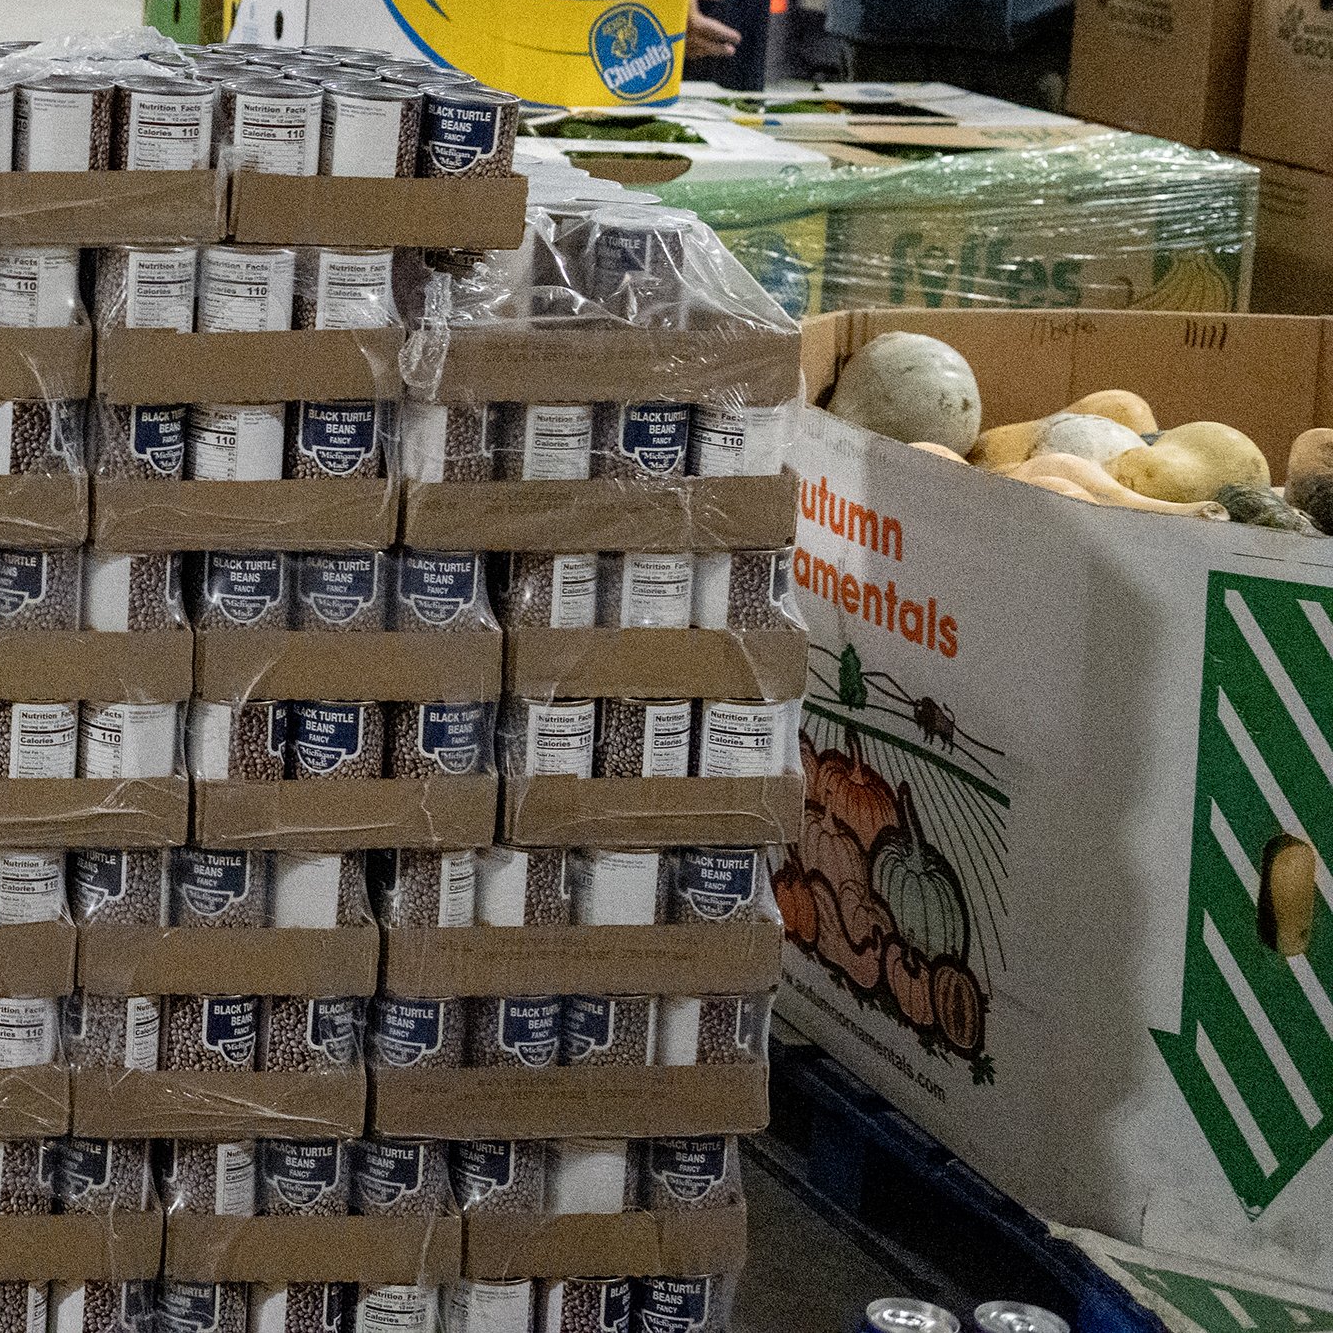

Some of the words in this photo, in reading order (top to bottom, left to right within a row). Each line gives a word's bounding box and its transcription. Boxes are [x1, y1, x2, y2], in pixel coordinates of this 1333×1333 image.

[604, 44, 671, 90] Chiquita
[139, 103, 175, 112] Nutrition
[244, 104, 279, 113] Nutrition
[456, 109, 491, 122] TURTLE
[138, 127, 172, 137] Calories
[182, 127, 200, 137] 110
[441, 121, 472, 133] BEANS
[243, 129, 277, 138] Calories
[286, 129, 305, 139] 110
[309, 409, 338, 422] BLACK
[340, 410, 371, 422] TURTLE
[325, 423, 356, 434] BEANS
[649, 423, 676, 434] BEANS
[244, 559, 277, 571] TURTLE
[336, 559, 371, 571] TURTLE
[437, 560, 470, 573] TURTLE
[230, 572, 260, 583] BEANS
[322, 572, 353, 584] BEANS
[423, 573, 454, 585] BEANS
[794, 548, 957, 658] amentals
[320, 710, 354, 722] TURTLE
[711, 711, 748, 721] Nutrition
[306, 721, 335, 734] BEANS
[101, 732, 121, 743] 110
[710, 735, 744, 745] Calories
[716, 858, 749, 870] TURTLE
[701, 869, 732, 881] BEANS
